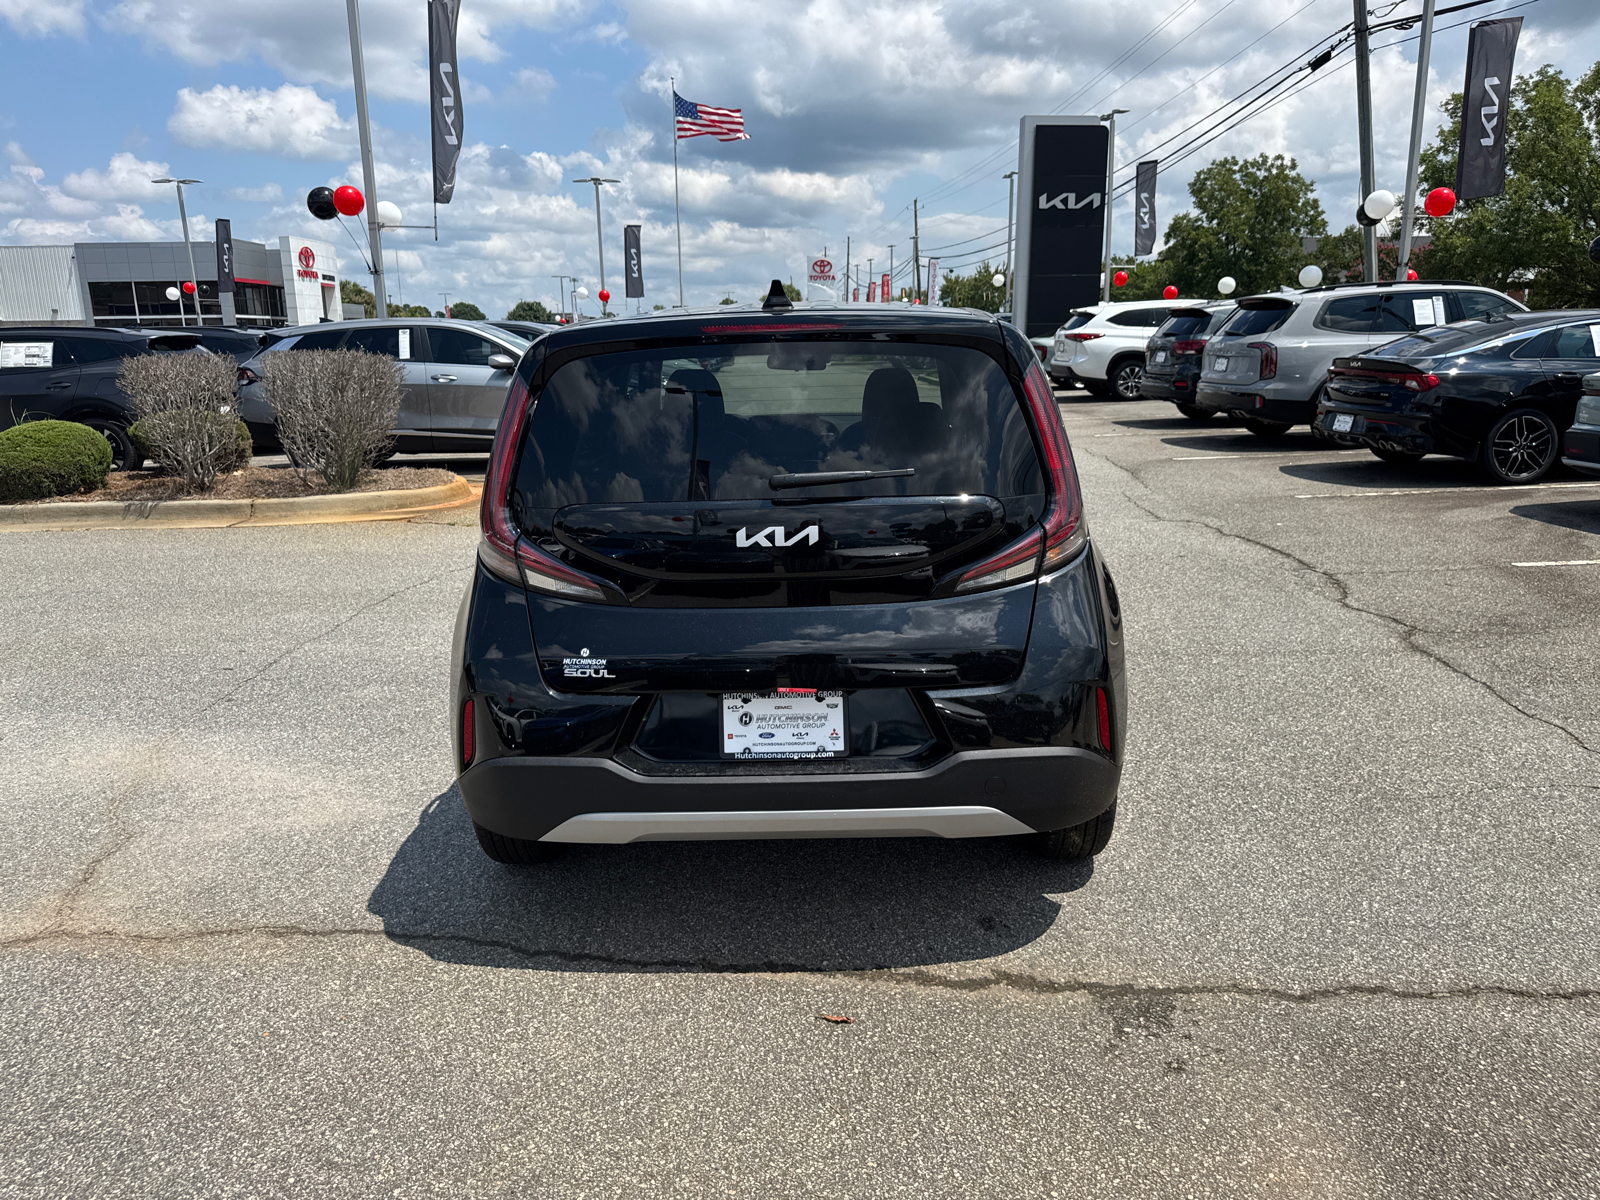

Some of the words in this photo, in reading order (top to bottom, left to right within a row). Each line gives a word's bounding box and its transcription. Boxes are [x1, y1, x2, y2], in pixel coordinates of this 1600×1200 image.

[1038, 192, 1101, 209] KIA
[297, 269, 319, 279] TOYOTA
[736, 525, 819, 547] KIA
[564, 669, 616, 678] SOUL
[770, 691, 816, 699] AUTOMOTIVE
[817, 690, 843, 698] GROUP
[755, 713, 829, 723] HUTCHINSON
[735, 752, 834, 760] Hutchinsonautogroup.com
